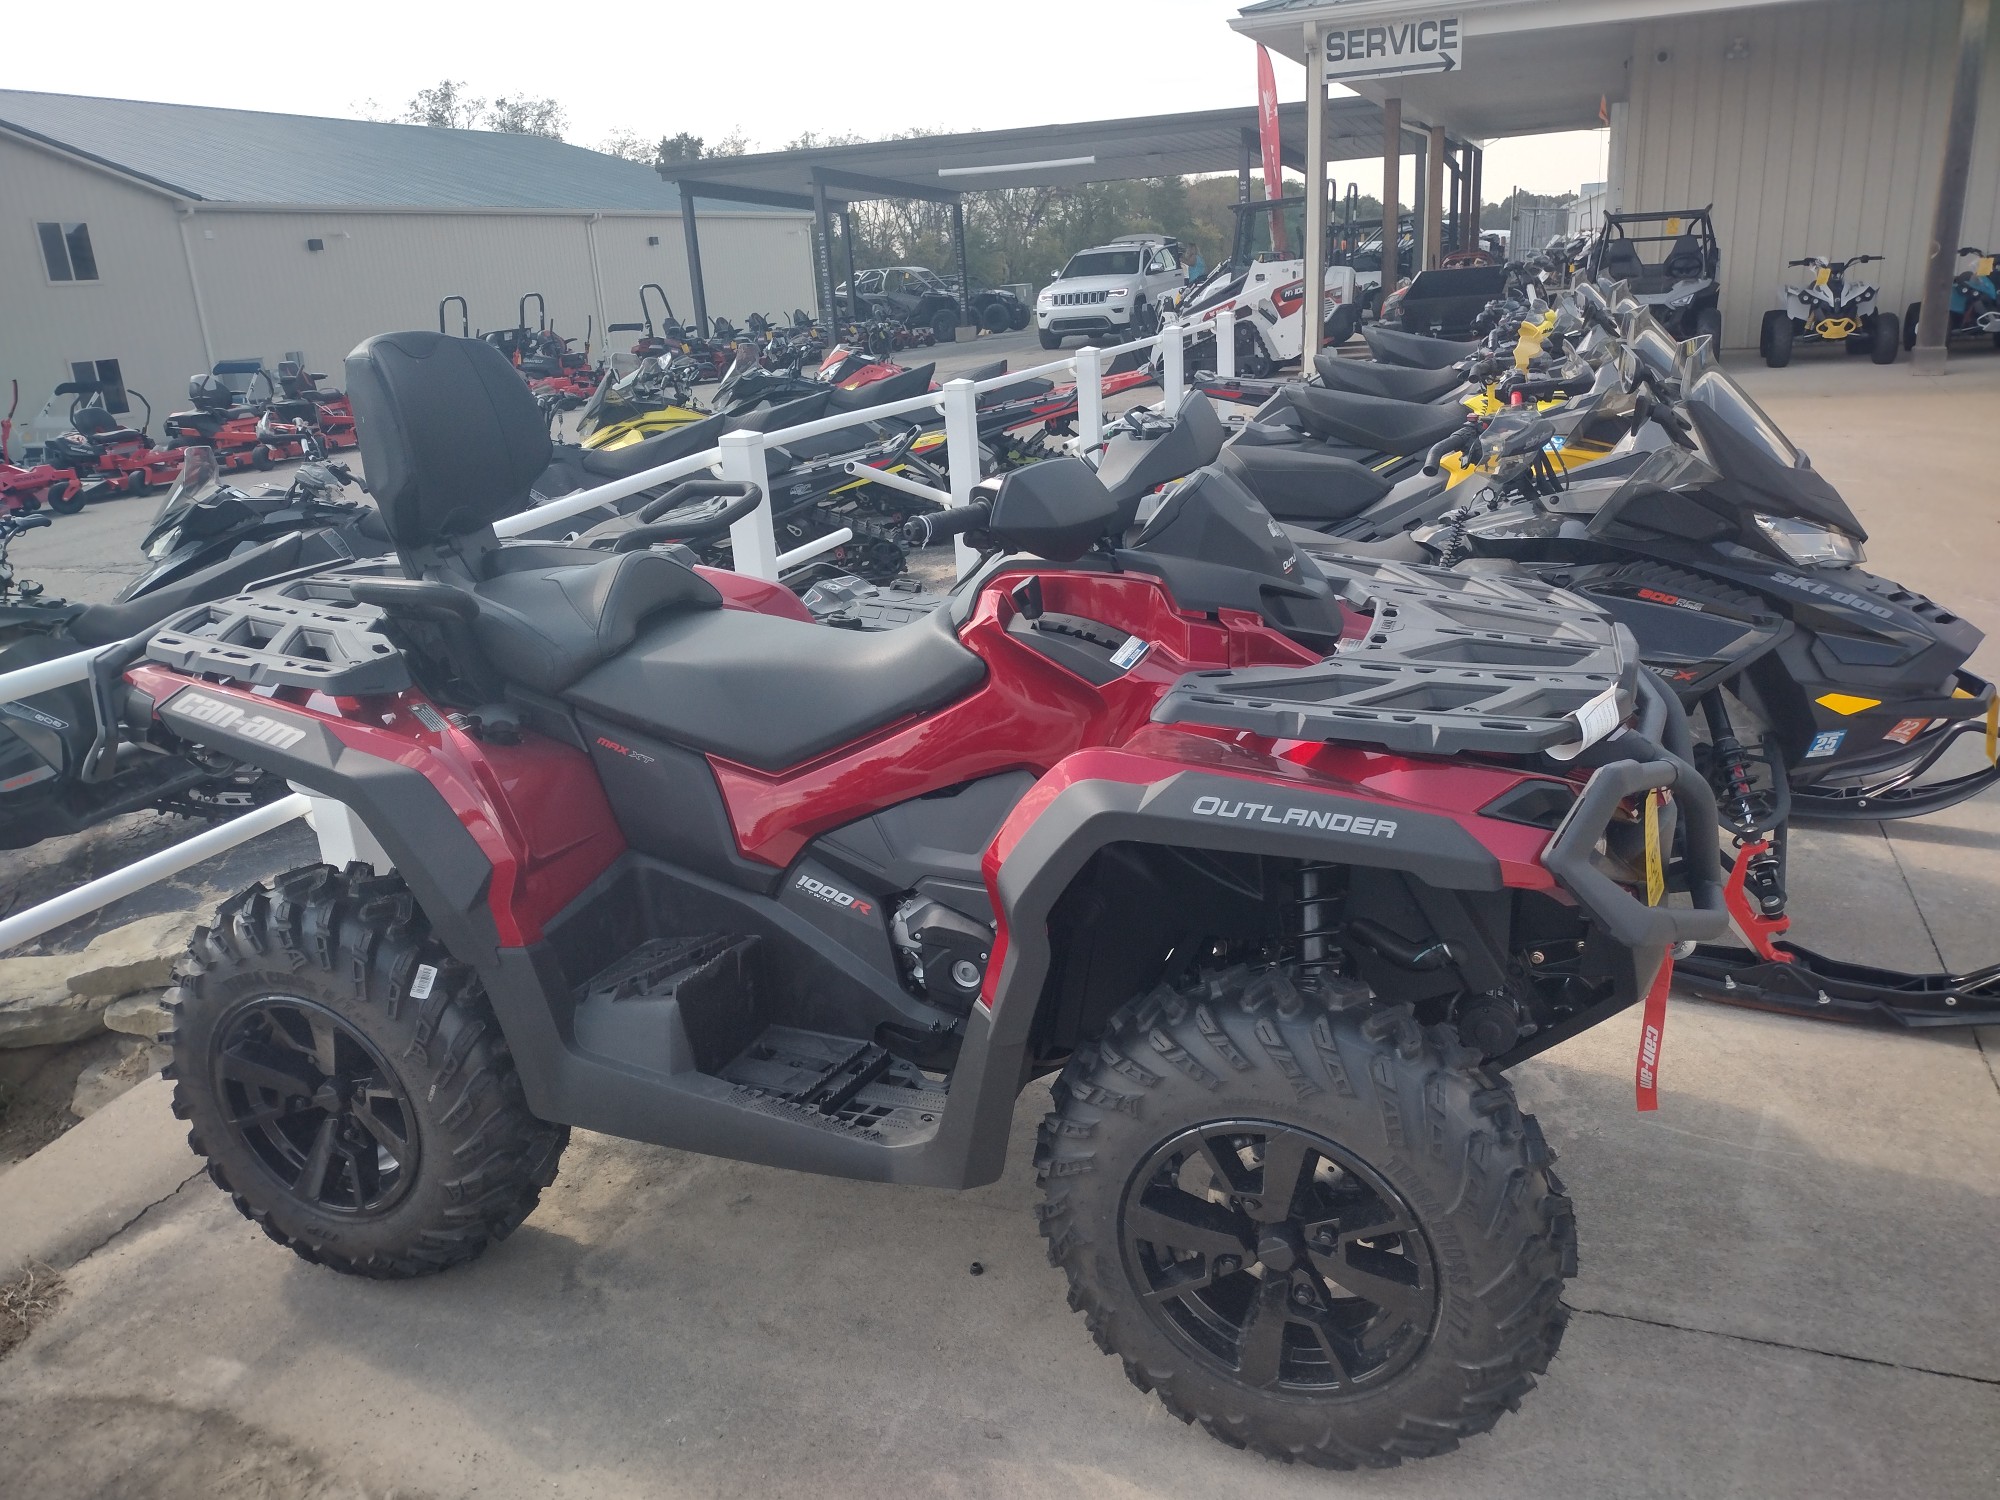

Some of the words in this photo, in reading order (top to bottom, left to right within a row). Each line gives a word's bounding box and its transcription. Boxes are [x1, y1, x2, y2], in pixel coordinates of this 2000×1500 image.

[1326, 18, 1458, 62] SERVICE
[1637, 588, 1679, 605] 900
[1770, 571, 1894, 619] ski-doo
[171, 692, 307, 750] can-am
[1894, 720, 1920, 736] 22
[596, 737, 629, 756] MAX
[628, 750, 655, 764] XT
[1812, 735, 1839, 751] 25
[1191, 795, 1398, 839] OUTLANDER
[797, 875, 872, 916] 1000R
[1639, 1024, 1659, 1089] can-am
